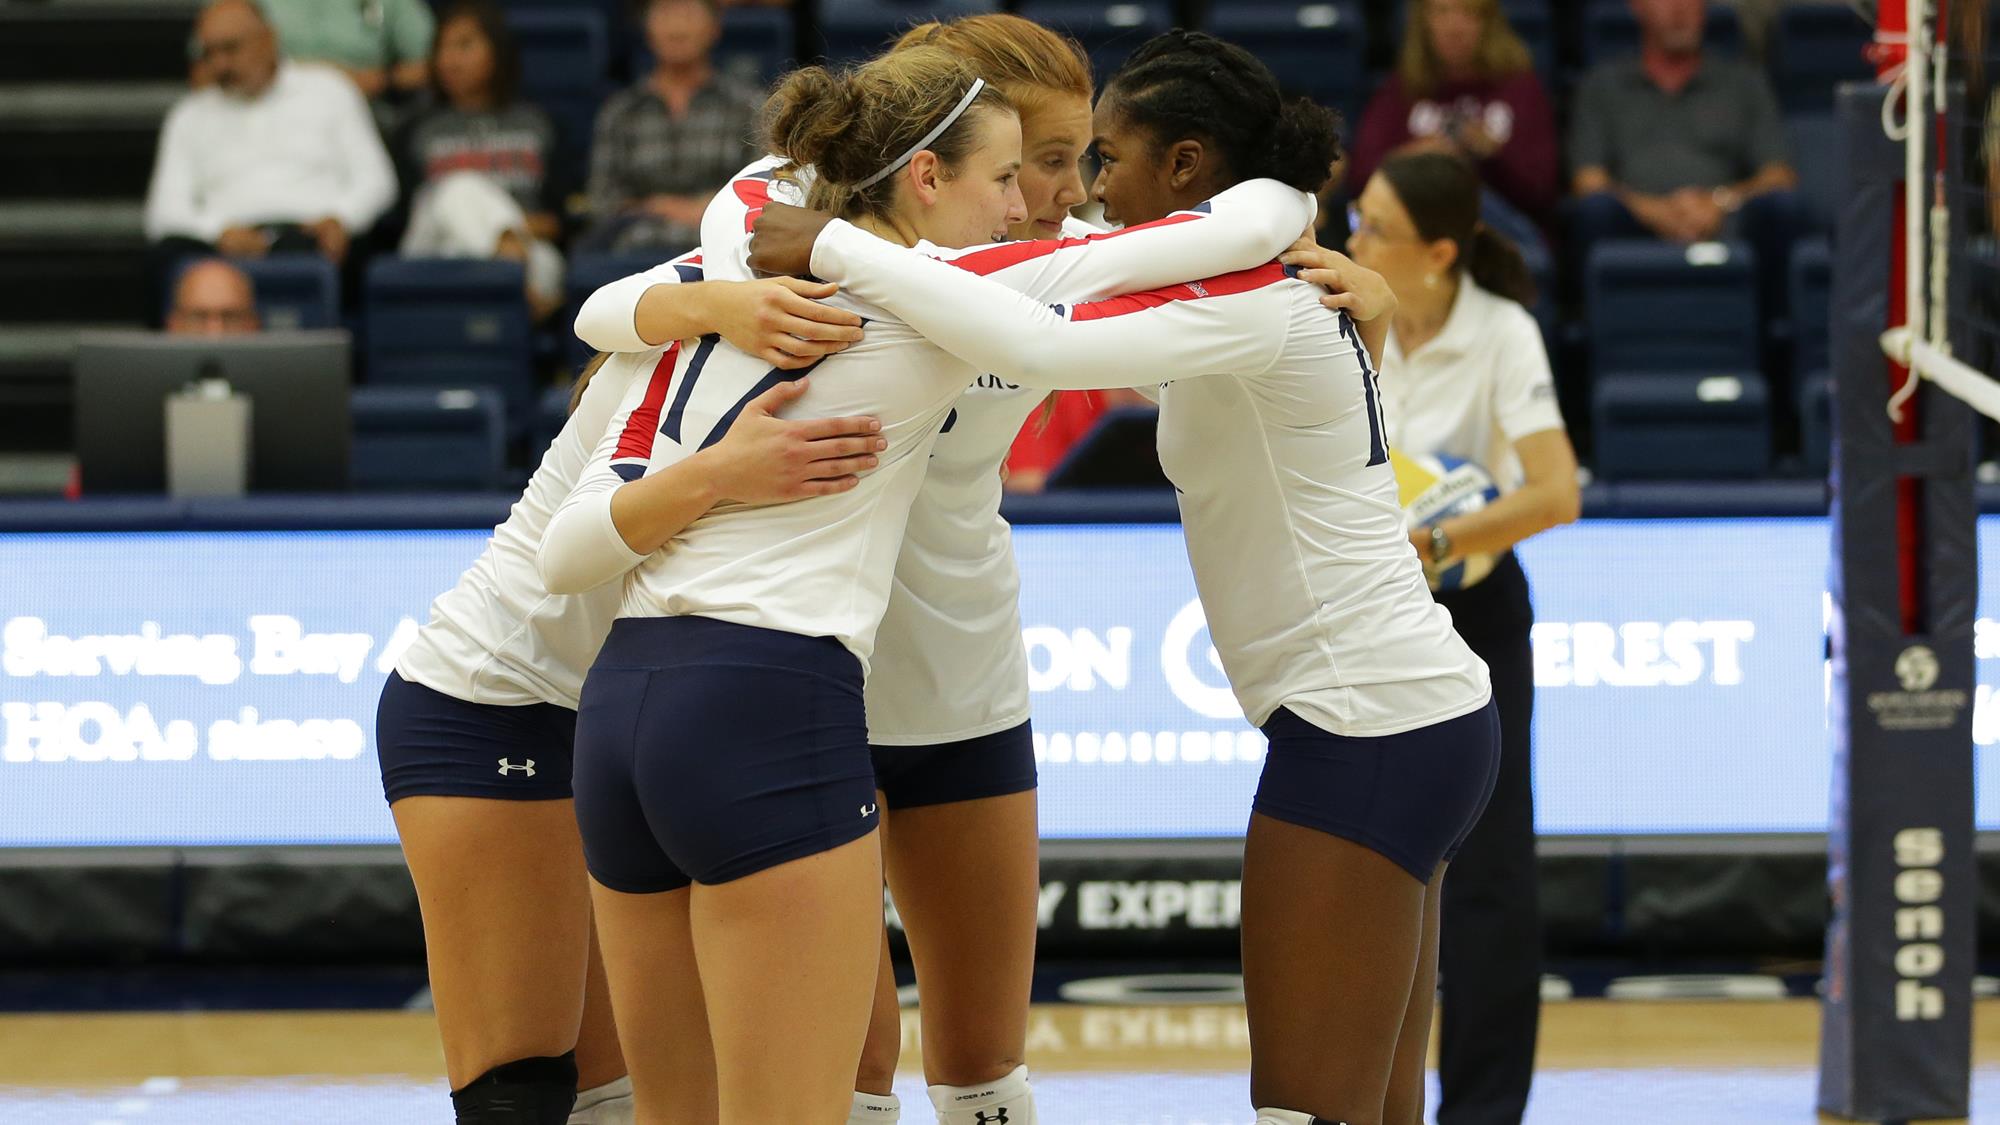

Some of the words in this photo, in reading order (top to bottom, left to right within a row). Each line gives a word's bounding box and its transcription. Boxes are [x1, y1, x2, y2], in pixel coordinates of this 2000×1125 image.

[4, 616, 241, 685] Serving
[249, 615, 374, 683] Bay
[2, 701, 198, 762] HOAs
[207, 705, 364, 760] since
